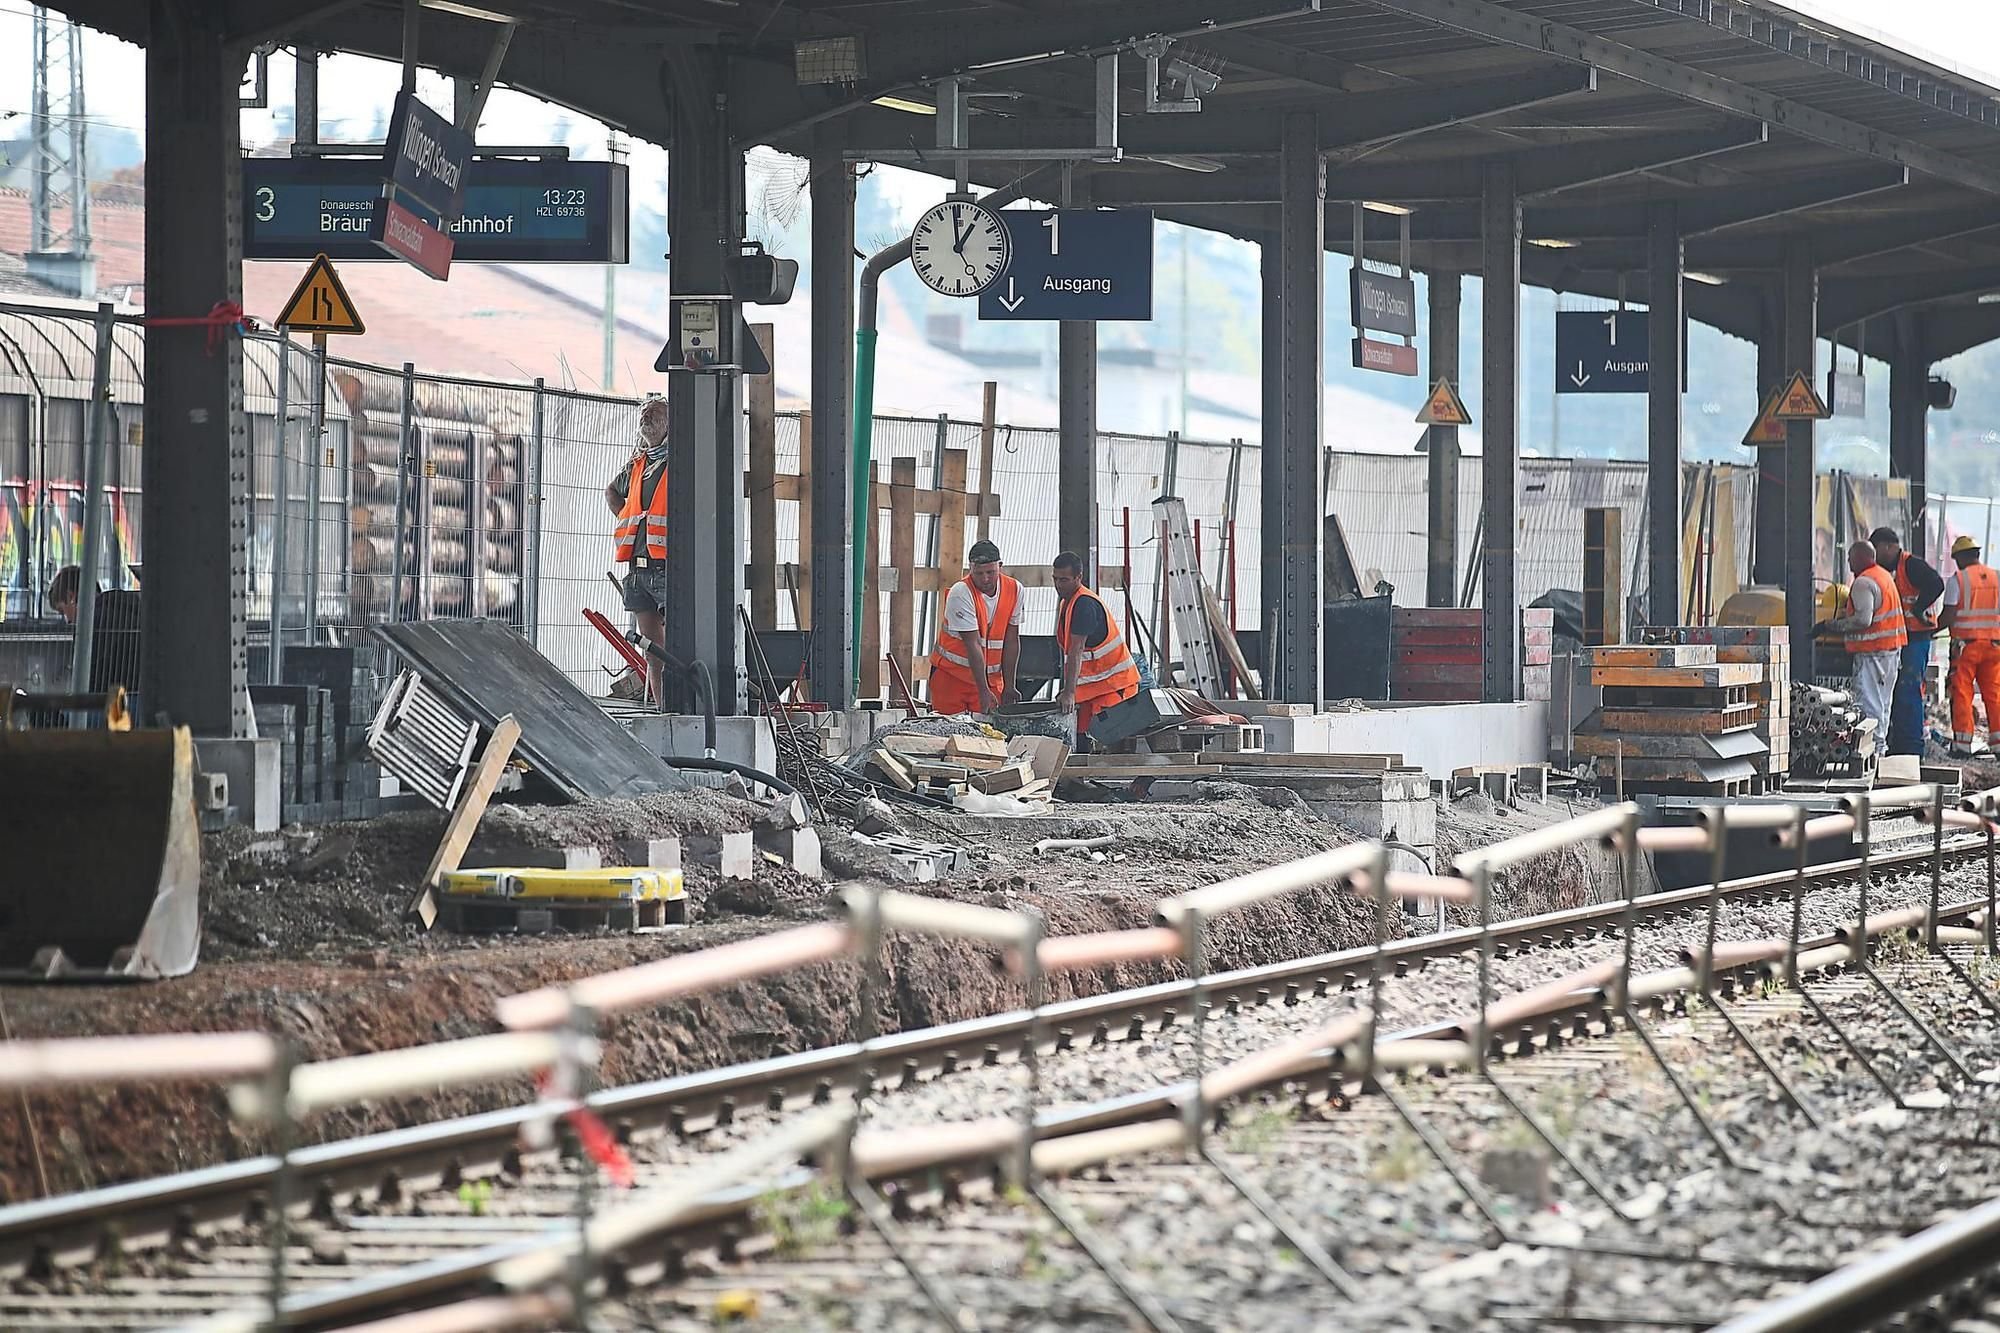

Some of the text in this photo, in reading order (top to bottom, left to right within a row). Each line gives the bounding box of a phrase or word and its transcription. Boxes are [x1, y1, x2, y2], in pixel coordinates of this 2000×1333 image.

[255, 187, 275, 222] 3
[320, 200, 374, 210] Donaueschi
[543, 189, 585, 205] 13:23
[536, 207, 585, 217] HZL 69736
[450, 215, 513, 233] ahnhof
[1042, 213, 1059, 255] 1
[1043, 275, 1111, 293] Ausgang
[1603, 315, 1616, 346] 1
[1604, 360, 1649, 374] Ausgan
